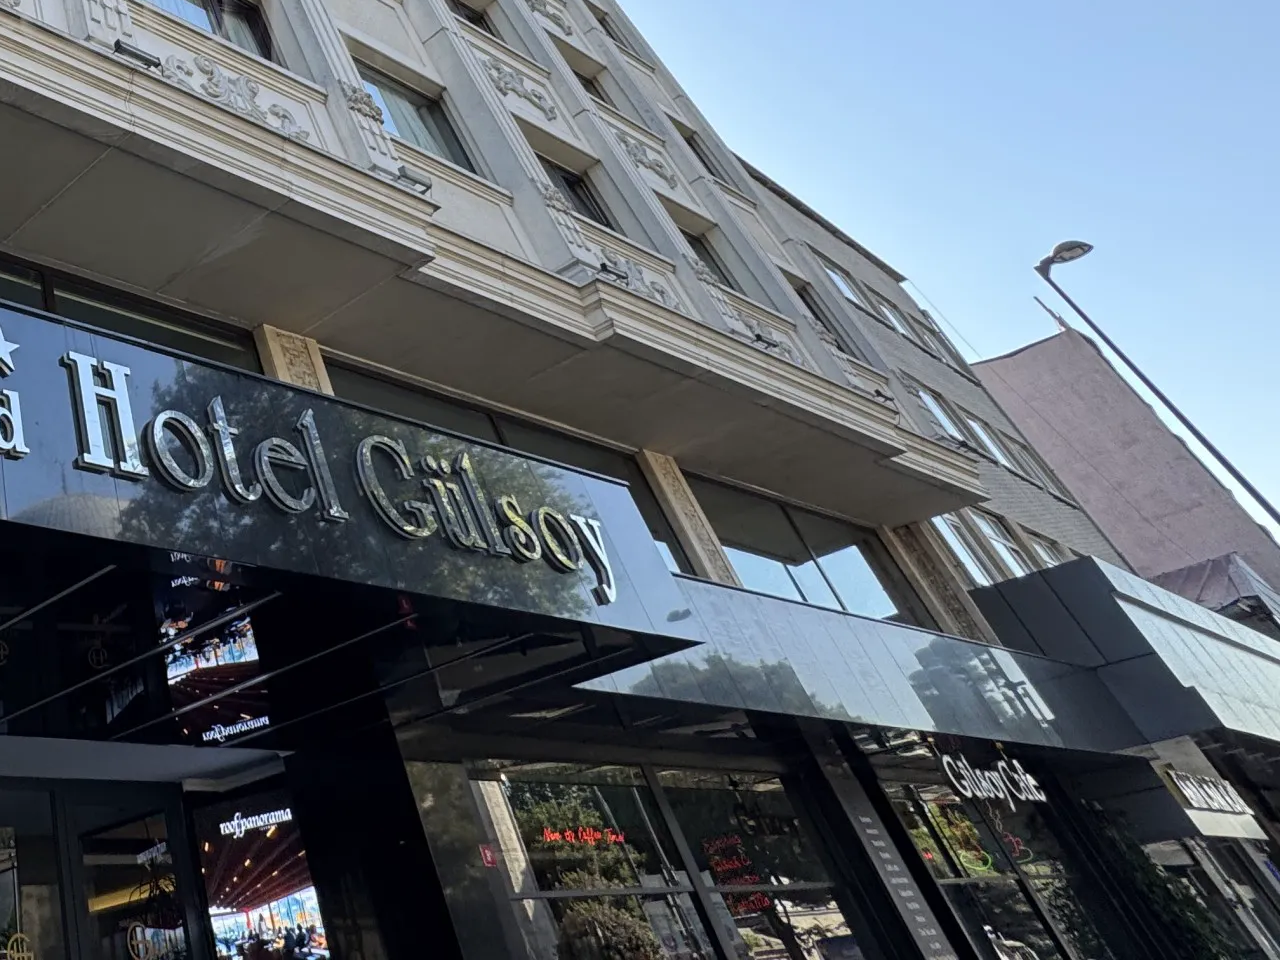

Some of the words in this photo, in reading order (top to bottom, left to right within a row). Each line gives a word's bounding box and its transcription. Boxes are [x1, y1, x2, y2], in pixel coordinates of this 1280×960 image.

[59, 350, 349, 523] Hotel
[356, 434, 617, 606] Gülsoy
[941, 751, 1017, 814] Gülsoy
[997, 758, 1048, 803] Cafe
